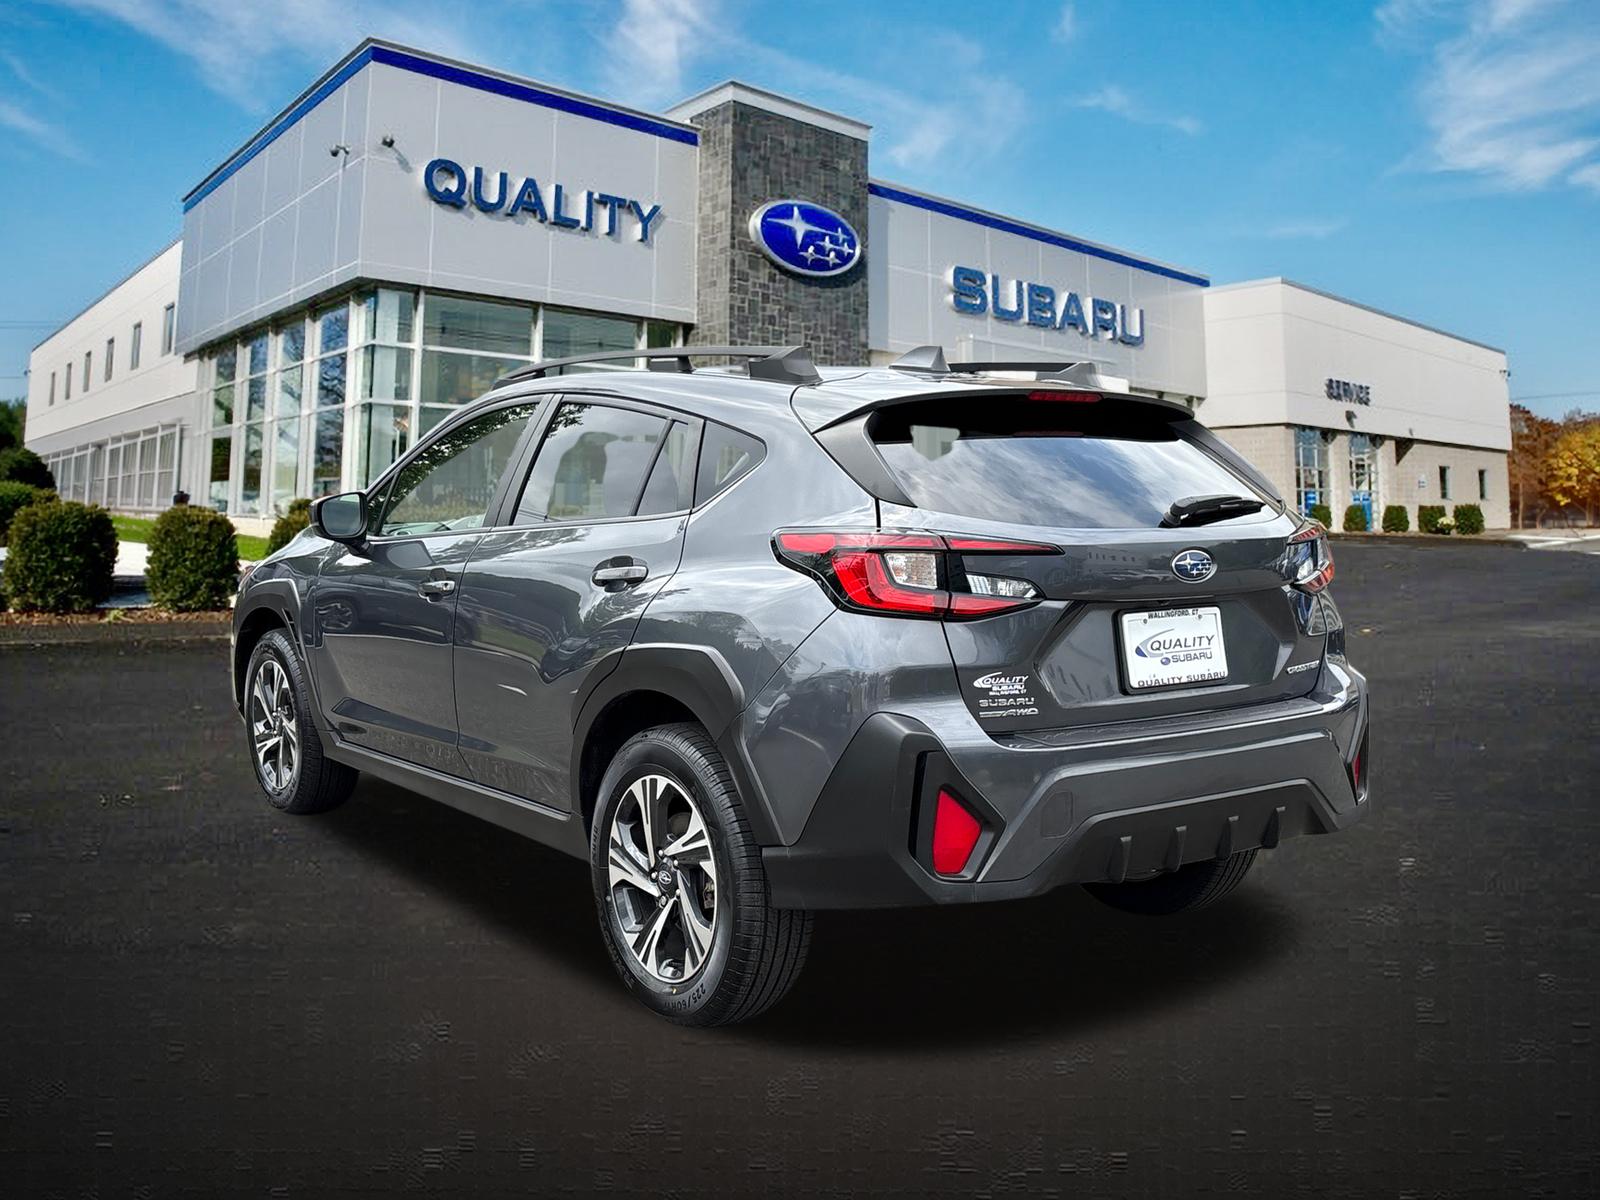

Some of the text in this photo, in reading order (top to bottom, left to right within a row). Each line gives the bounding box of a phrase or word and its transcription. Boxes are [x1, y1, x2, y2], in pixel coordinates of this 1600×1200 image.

[424, 158, 661, 243] QUALITY
[951, 266, 1145, 347] SUBARU
[1325, 378, 1370, 407] SERVICE
[1150, 635, 1215, 651] QUALITY
[1171, 651, 1213, 663] SUBARU
[983, 675, 1029, 685] QUALITY
[1137, 671, 1226, 687] QUALITY SUBARU
[979, 697, 1035, 707] SUBARU
[1002, 707, 1039, 717] AWD
